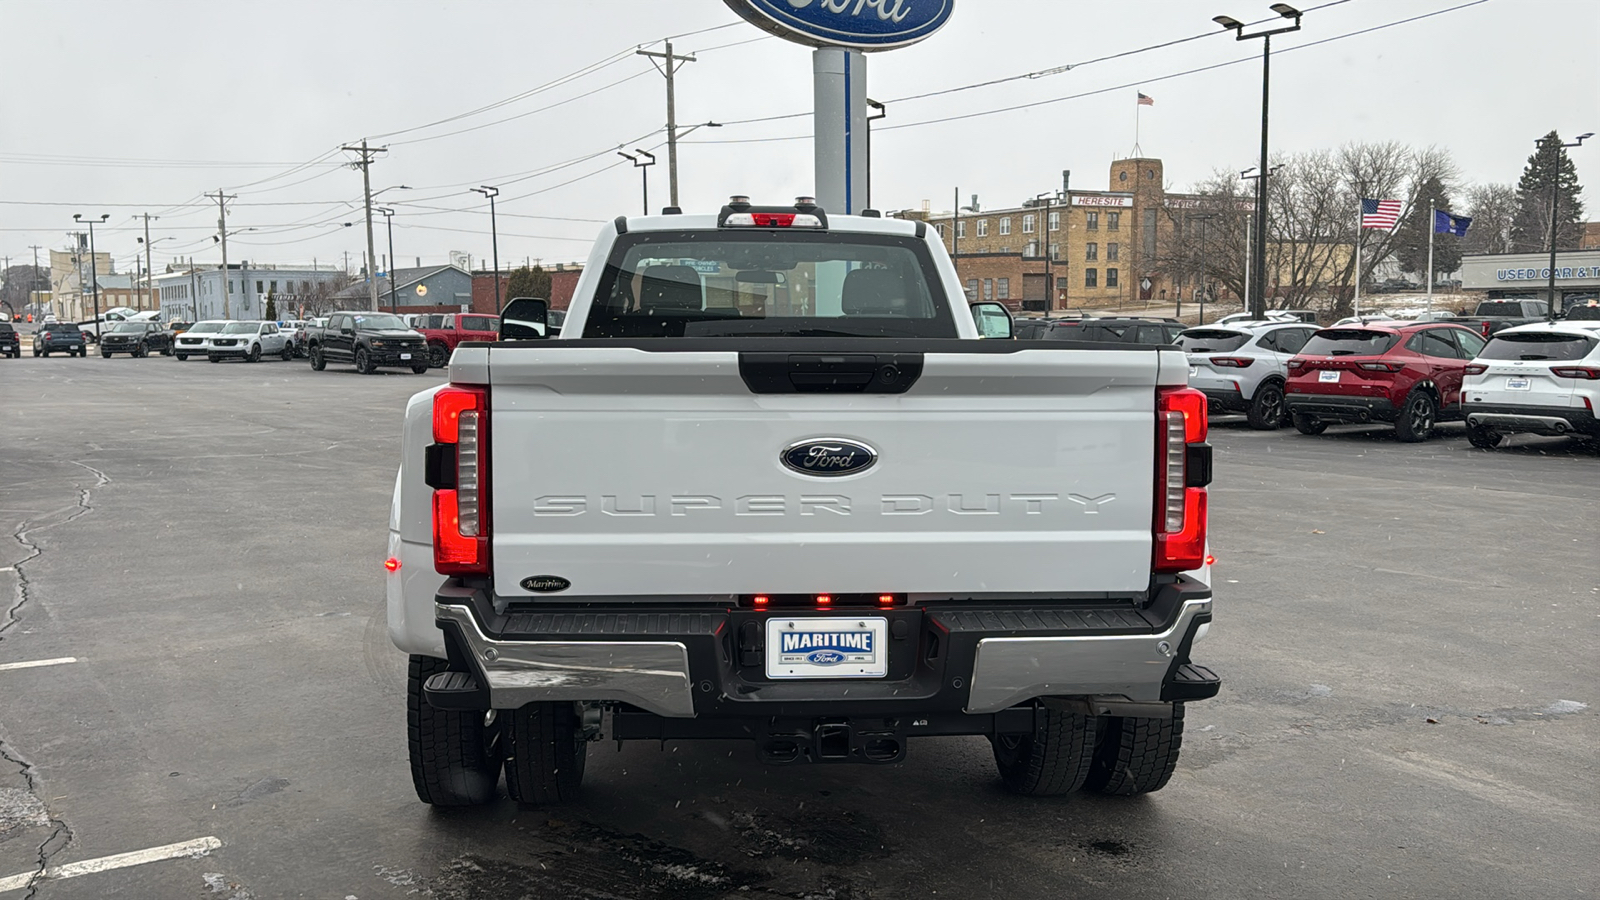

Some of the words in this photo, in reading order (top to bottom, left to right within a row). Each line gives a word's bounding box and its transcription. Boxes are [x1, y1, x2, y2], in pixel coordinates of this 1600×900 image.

[1077, 197, 1125, 206] HERESITE
[1497, 268, 1536, 280] USED
[1541, 267, 1572, 279] CAR
[1577, 266, 1587, 278] &
[803, 445, 855, 468] Ford
[533, 494, 852, 516] SUPER
[881, 493, 1116, 516] DUTY
[526, 579, 567, 590] Maritime
[783, 633, 871, 652] MARITIME
[813, 653, 839, 663] Ford
